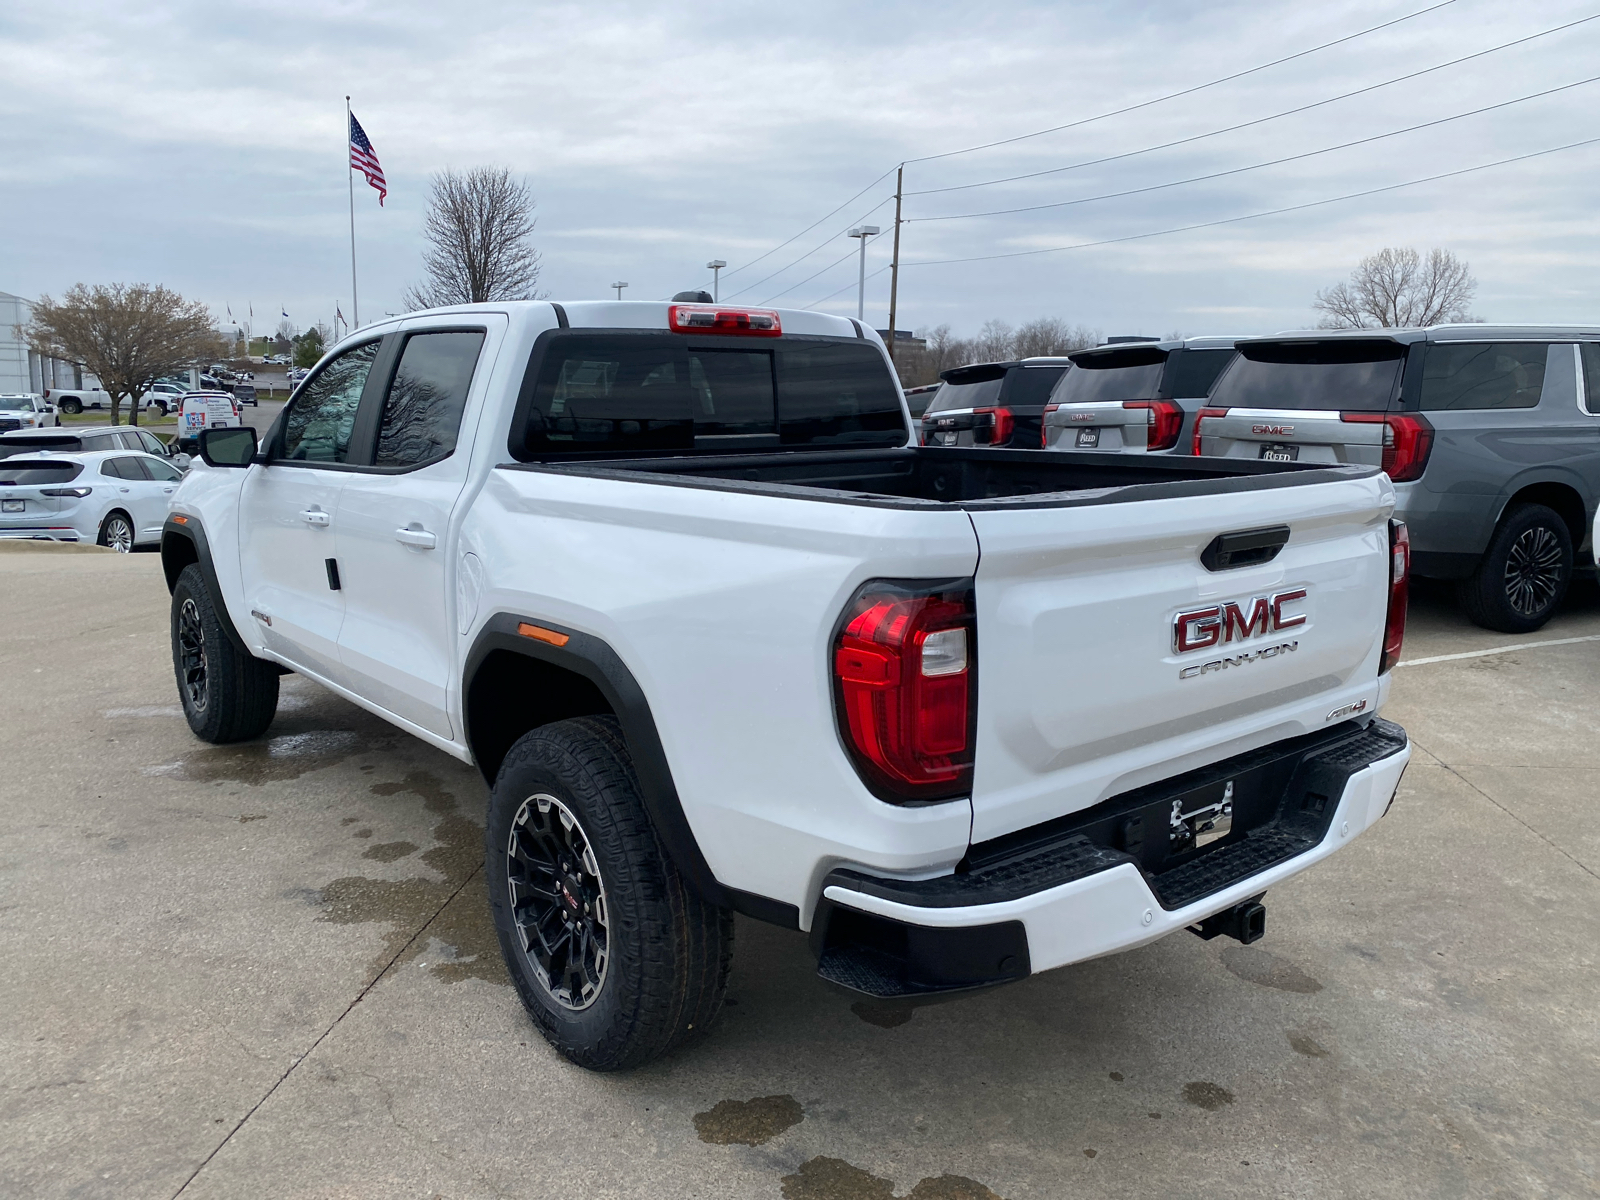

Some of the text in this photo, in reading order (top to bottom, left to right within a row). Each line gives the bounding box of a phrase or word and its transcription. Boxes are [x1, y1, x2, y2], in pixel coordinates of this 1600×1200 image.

[1070, 413, 1096, 422] GMC
[1252, 424, 1295, 436] GMC
[1263, 449, 1291, 461] REED
[1171, 587, 1307, 655] GMC
[1179, 640, 1299, 680] CANYON
[1326, 697, 1367, 721] AT4
